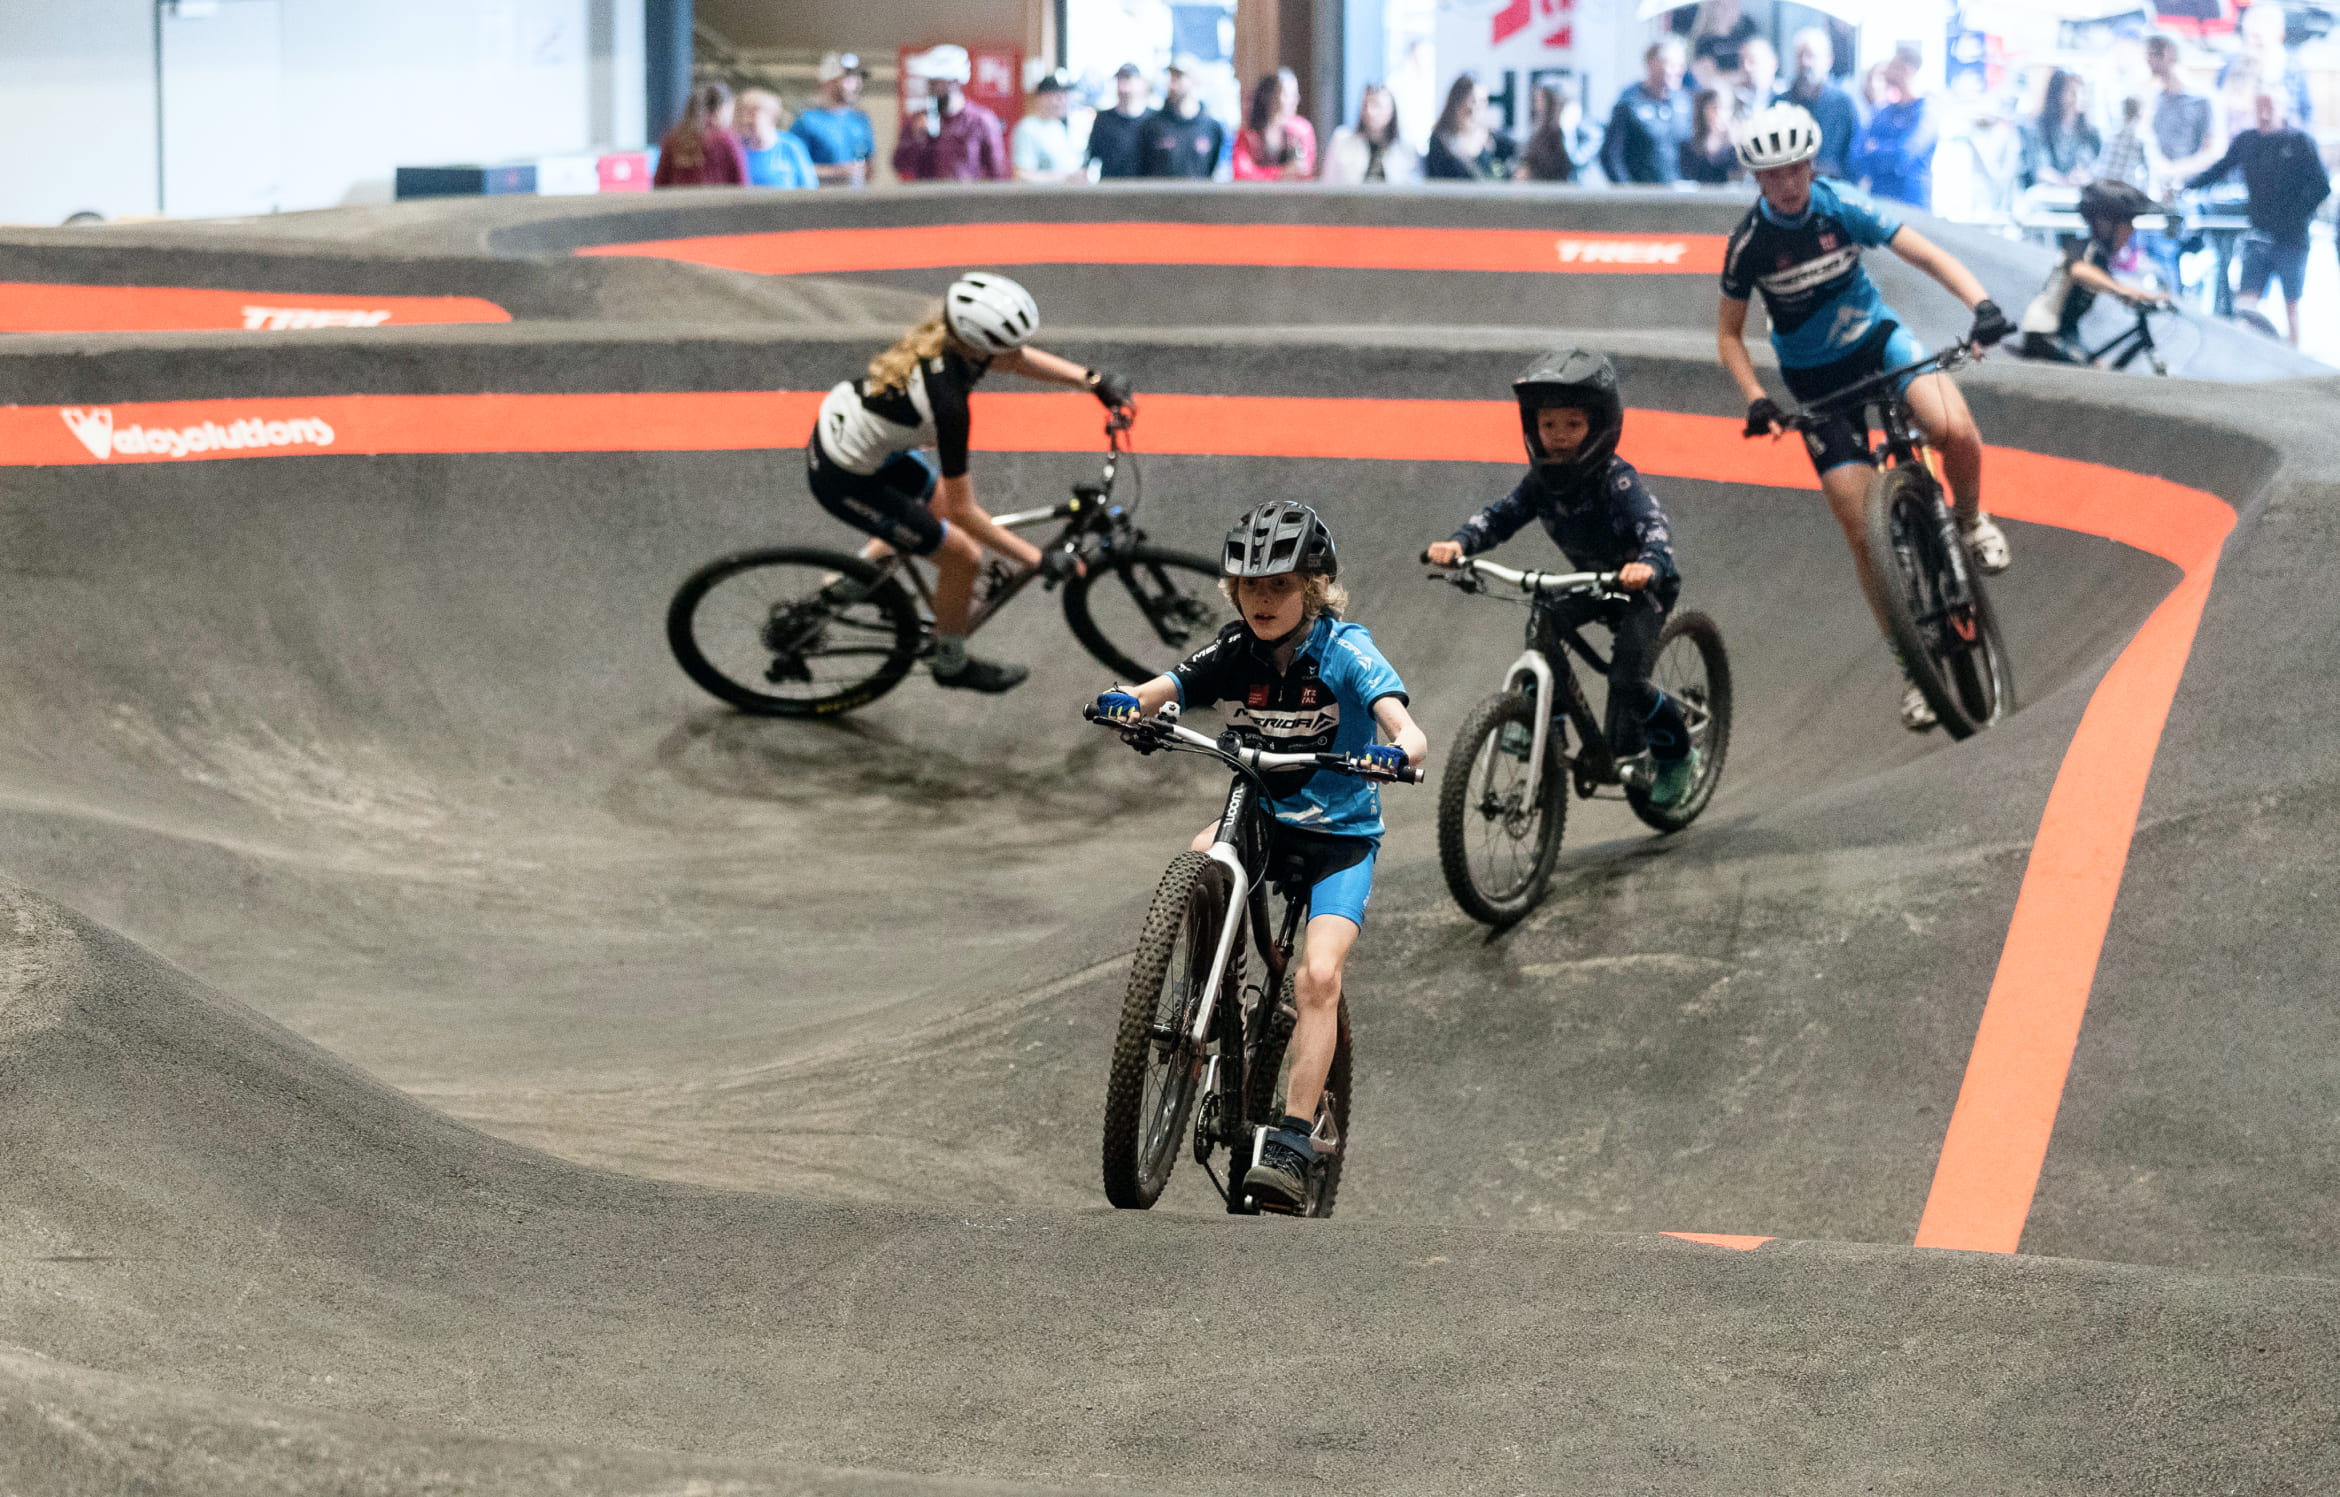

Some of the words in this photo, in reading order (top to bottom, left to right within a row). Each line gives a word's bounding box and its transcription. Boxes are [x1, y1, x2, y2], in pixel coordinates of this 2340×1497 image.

[1555, 239, 1687, 264] TREK
[241, 305, 391, 330] TREK
[1223, 788, 1244, 828] woom
